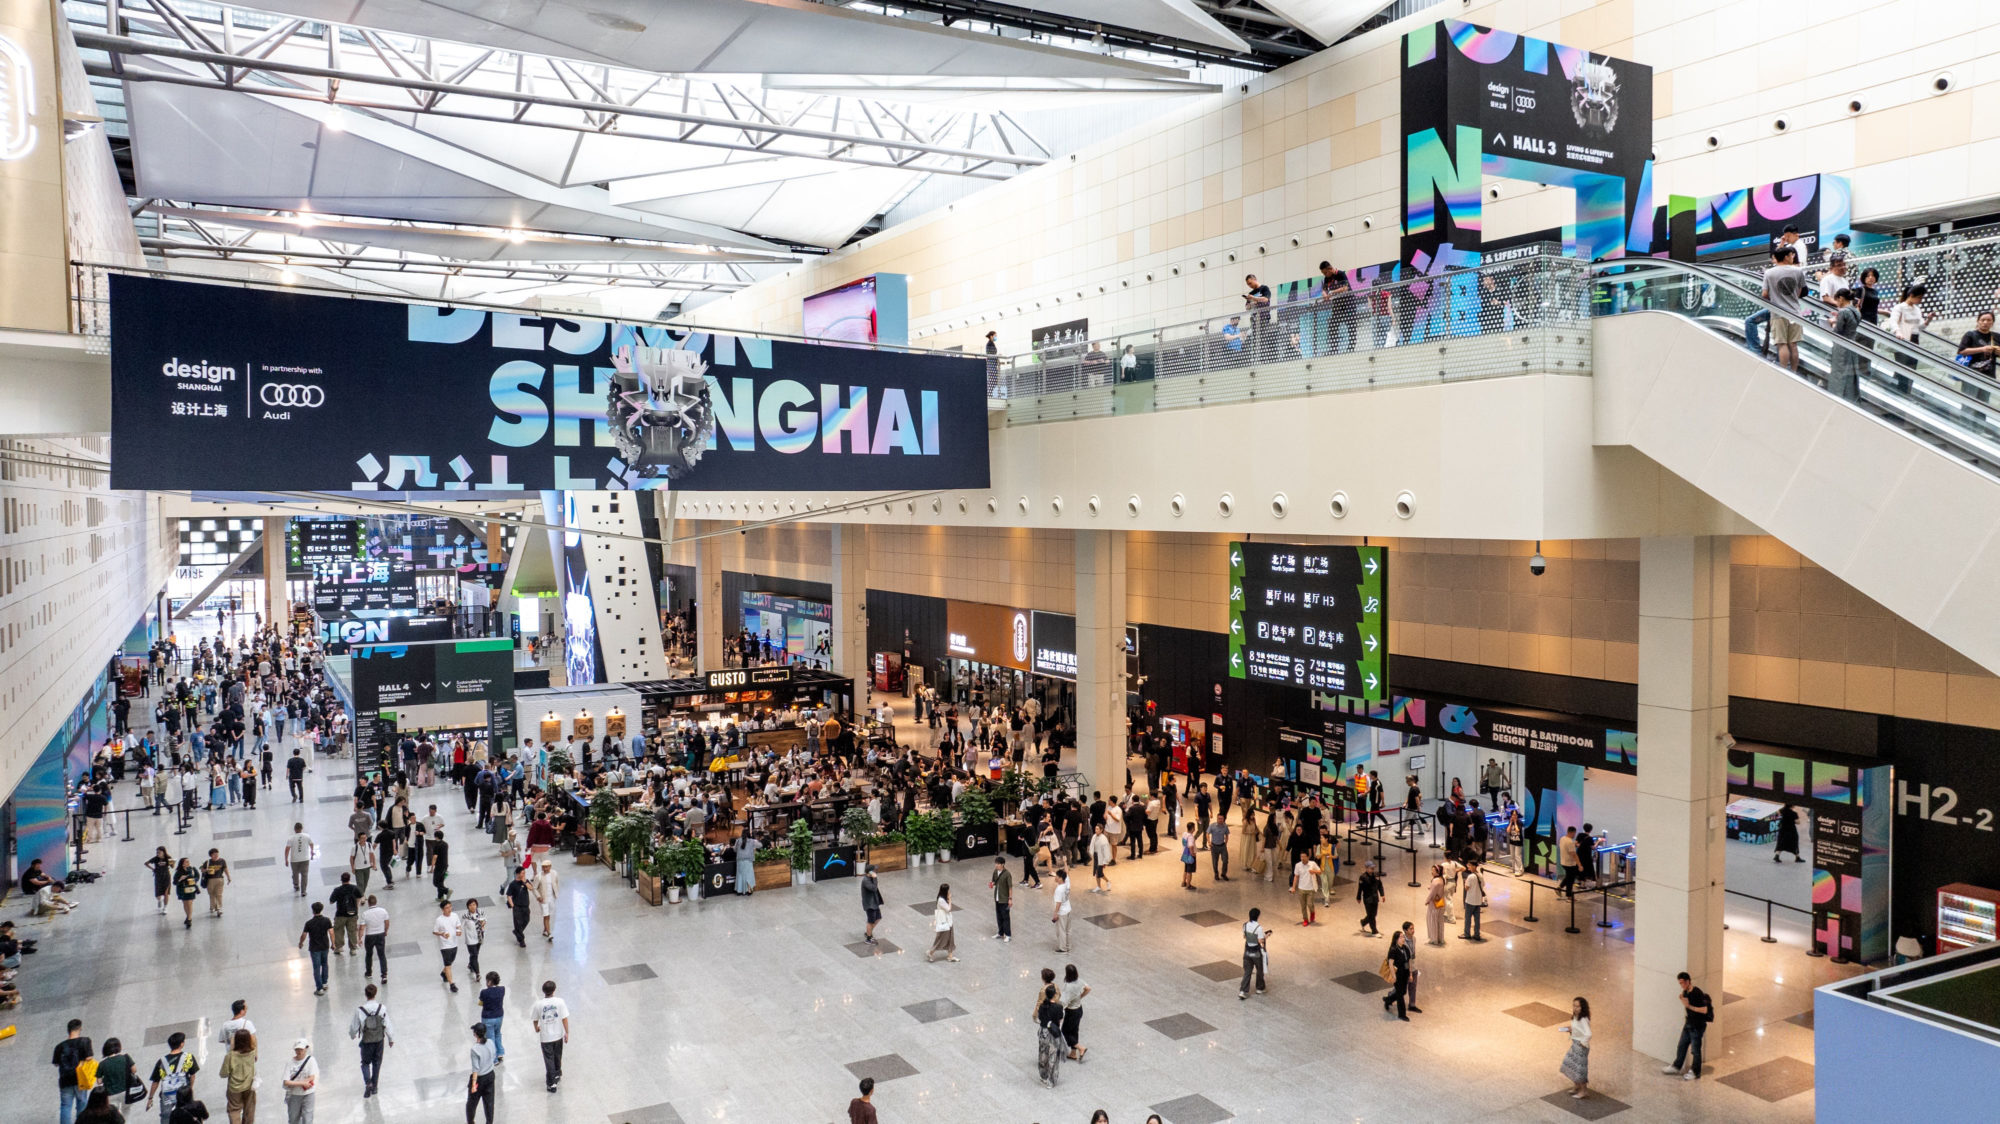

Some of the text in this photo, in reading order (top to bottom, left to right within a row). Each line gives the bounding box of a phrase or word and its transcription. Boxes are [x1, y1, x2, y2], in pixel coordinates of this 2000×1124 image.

[1488, 81, 1509, 94] design
[1513, 135, 1557, 155] HALL 3
[1566, 144, 1584, 153] LIVING
[1590, 148, 1614, 158] LIFESTYLE
[1494, 245, 1540, 262] LIFESTYLE
[162, 357, 236, 383] design
[270, 364, 307, 374] partnership
[308, 367, 323, 375] with
[177, 382, 222, 392] SHANGHAI
[171, 401, 228, 417] 设计上海
[487, 358, 941, 456] SHNGHAI
[263, 411, 291, 420] Audi
[313, 562, 389, 586] 计上海
[1284, 593, 1296, 603] H4
[1323, 596, 1335, 607] H3
[1037, 649, 1077, 666] 上海世博展览
[1249, 651, 1255, 661] 8
[1249, 664, 1258, 676] 13
[1309, 659, 1316, 670] 7
[710, 671, 746, 687] GUSTO
[1309, 674, 1316, 685] 8
[378, 684, 401, 692] HALL
[1492, 723, 1594, 748] KITCHEN & BATHROOM
[1492, 732, 1526, 746] DESIGN
